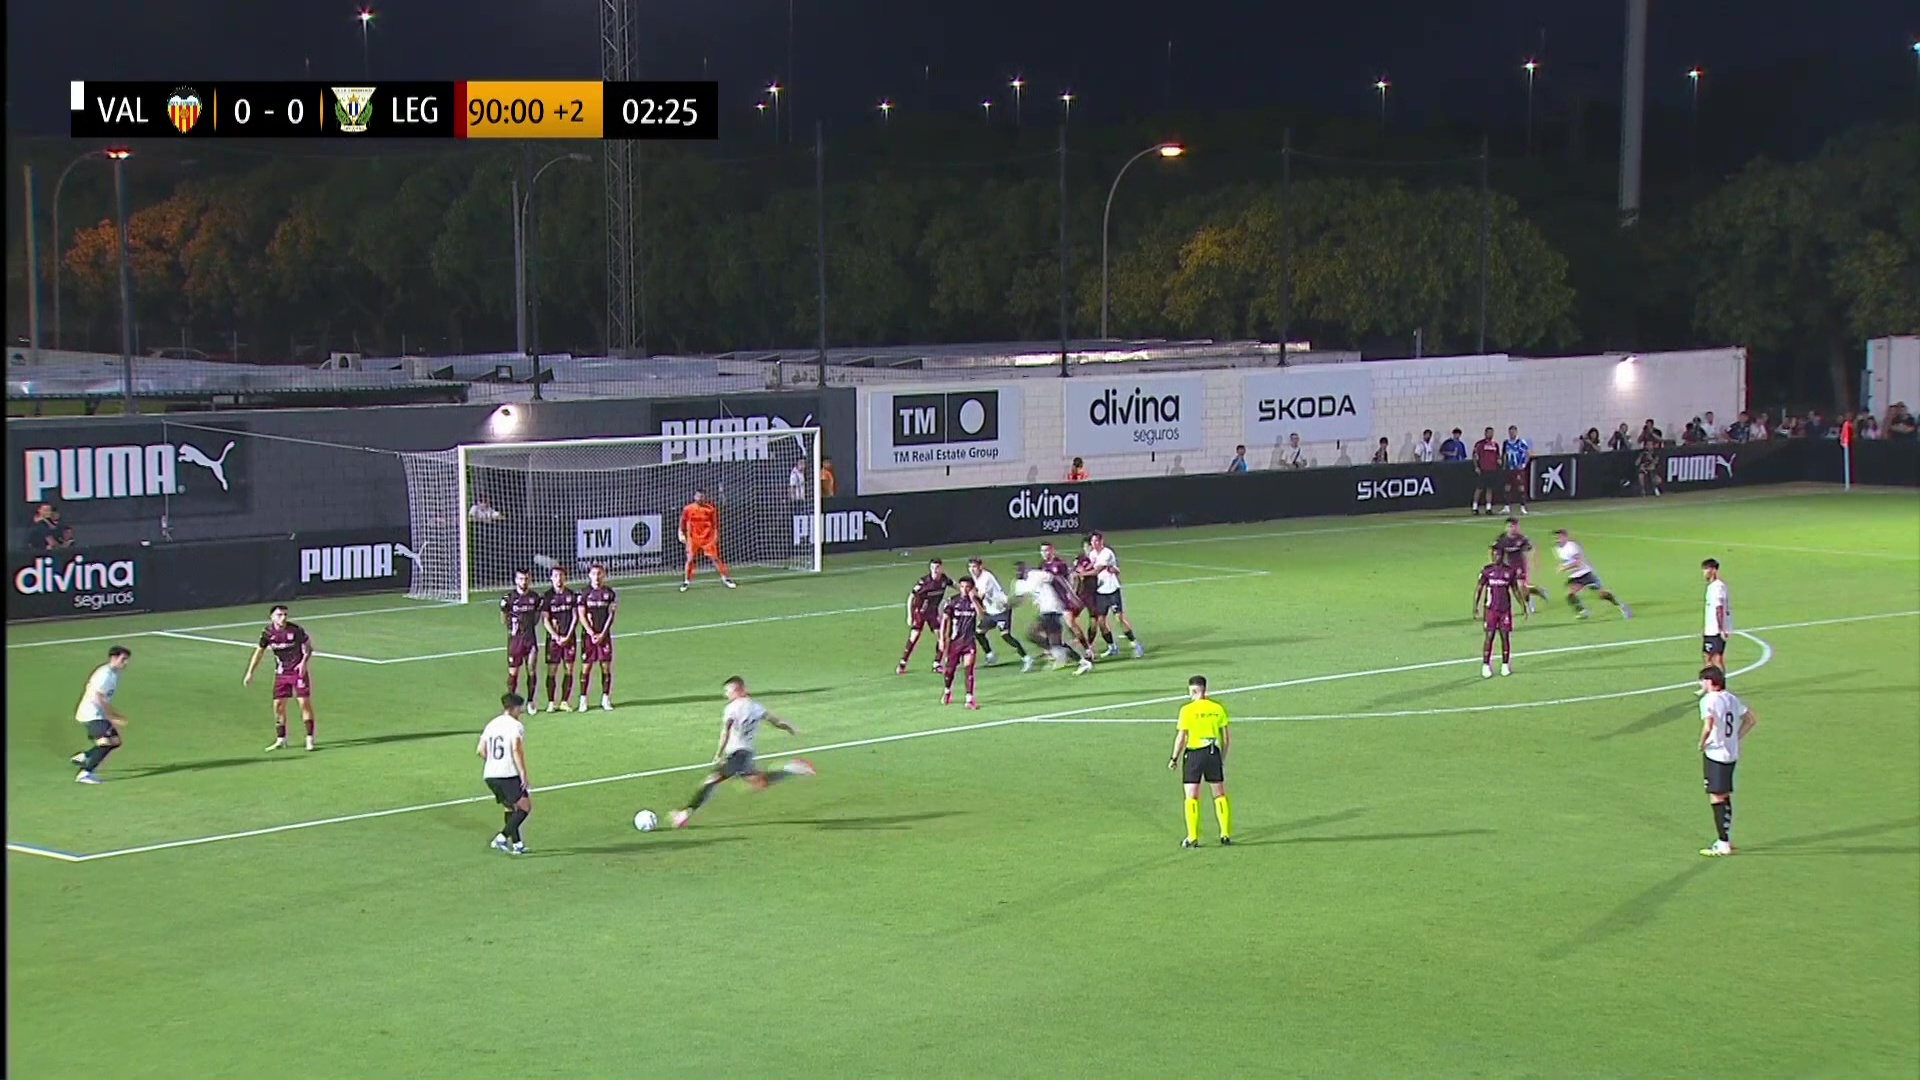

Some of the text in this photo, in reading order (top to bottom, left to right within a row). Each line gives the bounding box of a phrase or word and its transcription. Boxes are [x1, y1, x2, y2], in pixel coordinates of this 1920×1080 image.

[899, 406, 936, 436] TM
[1089, 387, 1180, 426] divina
[661, 416, 768, 465] PUMA
[1133, 427, 1180, 446] seguros
[893, 446, 999, 463] TM Real Estate Group
[1667, 454, 1716, 483] PUMA
[24, 444, 176, 502] PUMA
[1008, 488, 1080, 520] divina
[582, 527, 613, 549] TM
[1042, 517, 1080, 533] seguros
[15, 554, 135, 595] divina
[301, 543, 393, 583] PUMA
[73, 591, 135, 610] seguros
[1725, 710, 1735, 738] 8
[489, 735, 505, 760] 16
